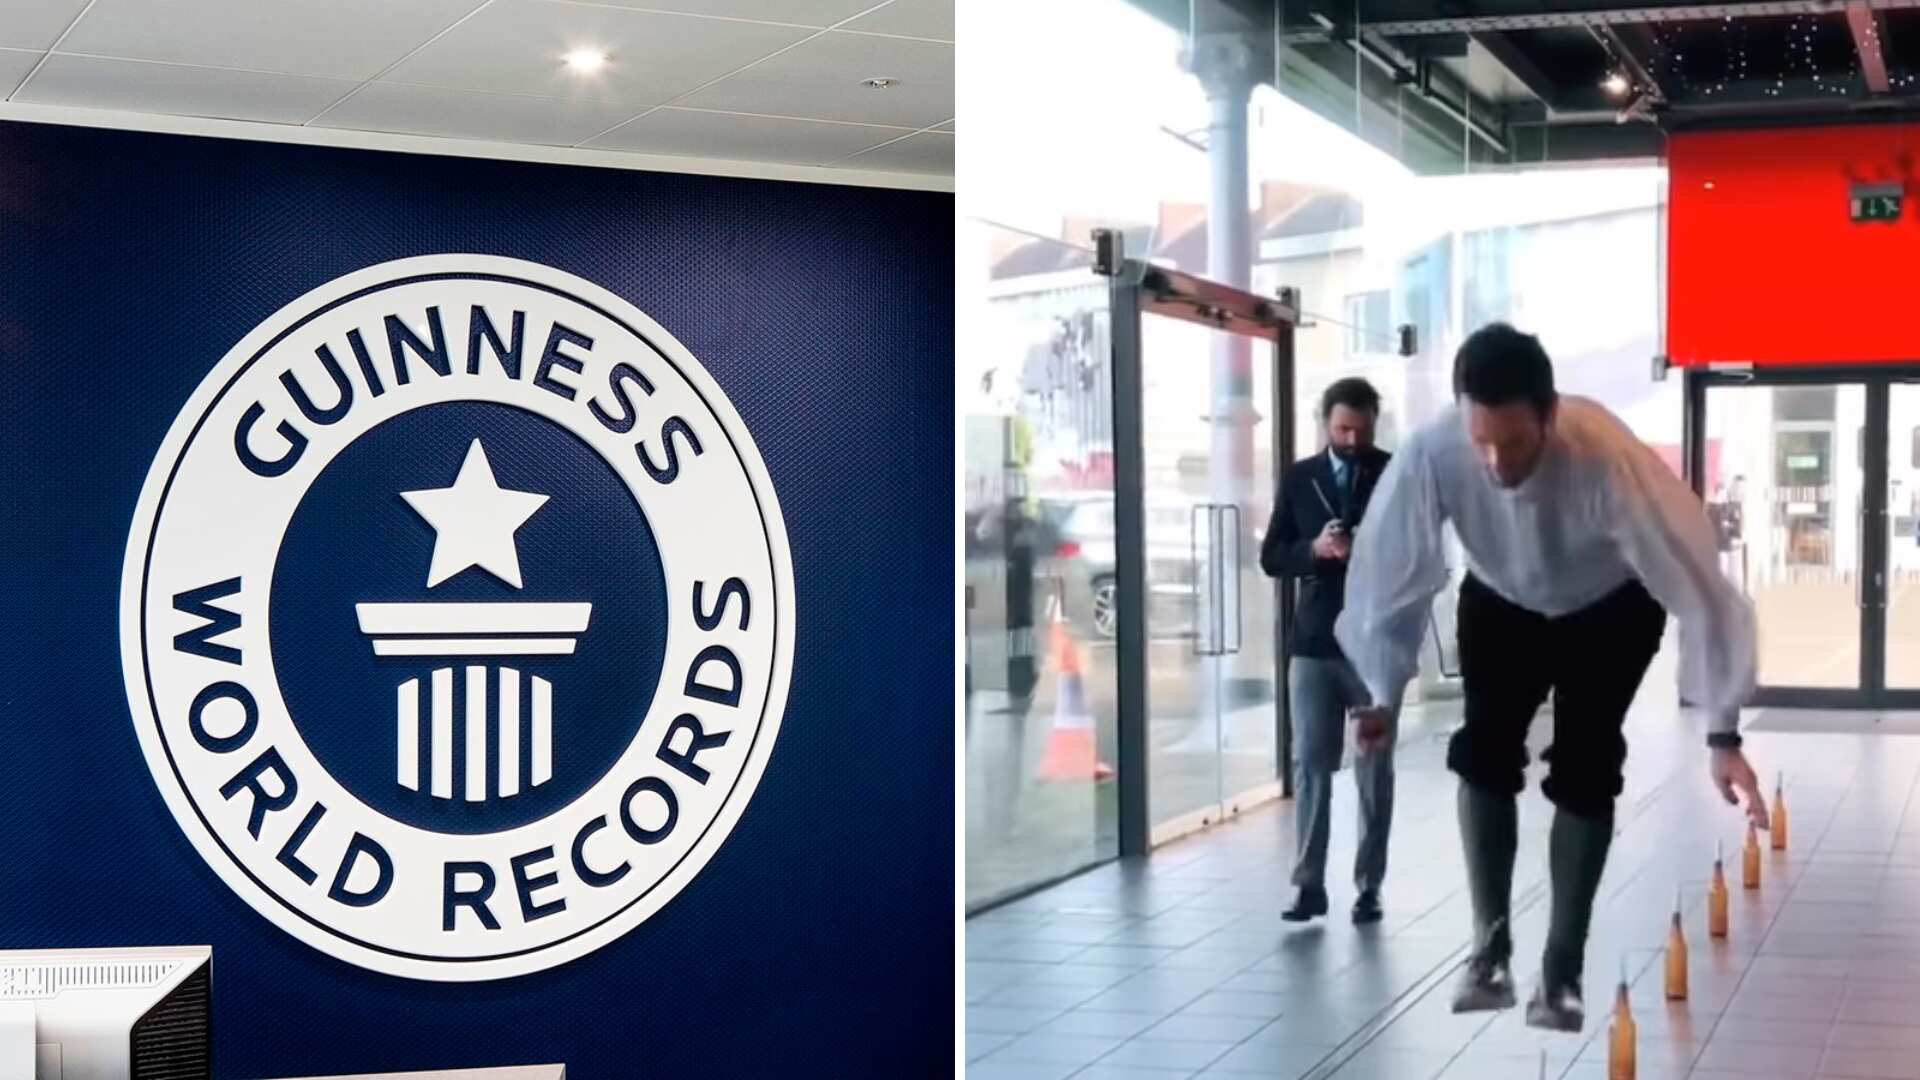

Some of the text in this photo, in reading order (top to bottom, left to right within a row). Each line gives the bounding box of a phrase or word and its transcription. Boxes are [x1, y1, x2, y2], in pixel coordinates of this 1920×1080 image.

[234, 305, 704, 485] GUINNESS
[172, 576, 752, 931] WORLD RECORDS
